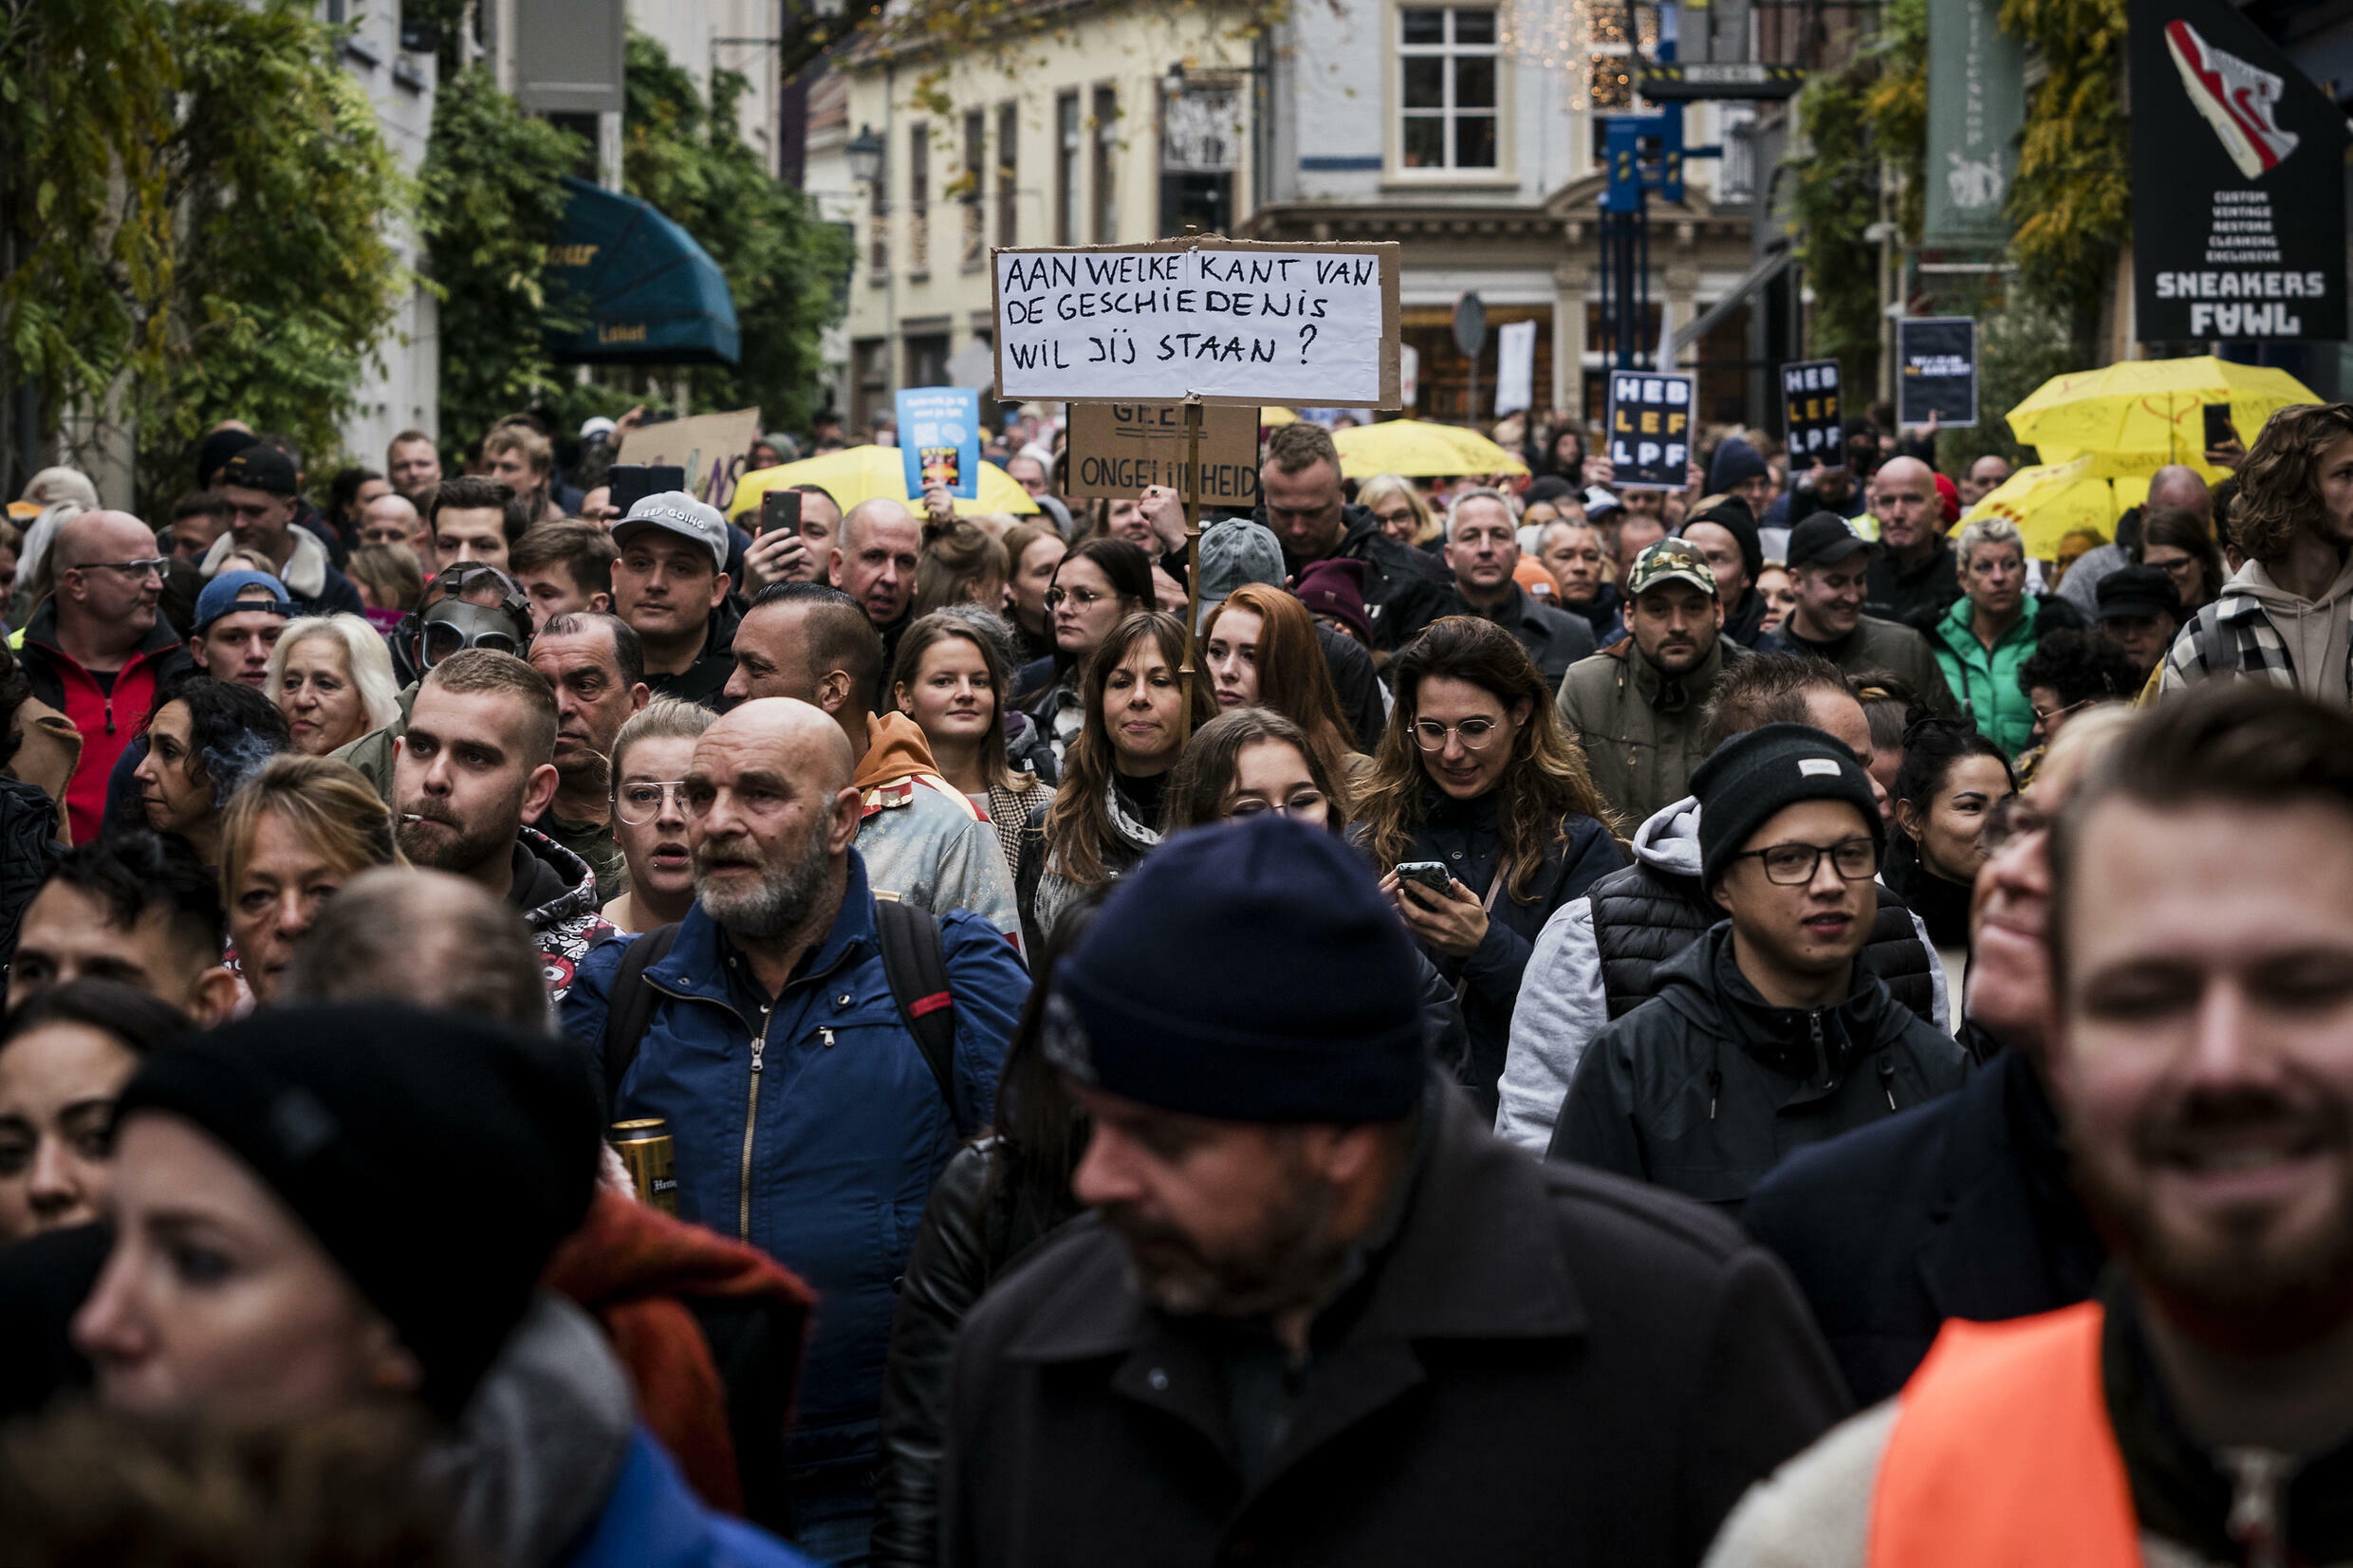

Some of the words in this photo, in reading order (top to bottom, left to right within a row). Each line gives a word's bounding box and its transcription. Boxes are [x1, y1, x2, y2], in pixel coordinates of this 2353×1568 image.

[2212, 205, 2272, 218] VINTAGE
[2208, 235, 2278, 249] CLEANING
[2205, 249, 2282, 264] EXCLUSIVE
[1004, 255, 1077, 293] AAN
[1084, 254, 1181, 286] WELKE
[1200, 255, 1301, 285] KANT
[1315, 258, 1374, 286] VAN
[2155, 270, 2325, 299] SNEAKERS
[1007, 295, 1047, 326] DE
[1156, 333, 1276, 363] STAAN
[1299, 323, 1318, 365] ?
[1616, 378, 1690, 404] HEB
[1786, 366, 1839, 392] HEB
[1615, 410, 1687, 434] LEF
[1788, 397, 1838, 422] LEF
[1789, 427, 1841, 454] LPF
[1613, 440, 1687, 468] LPF
[667, 507, 706, 531] GOING
